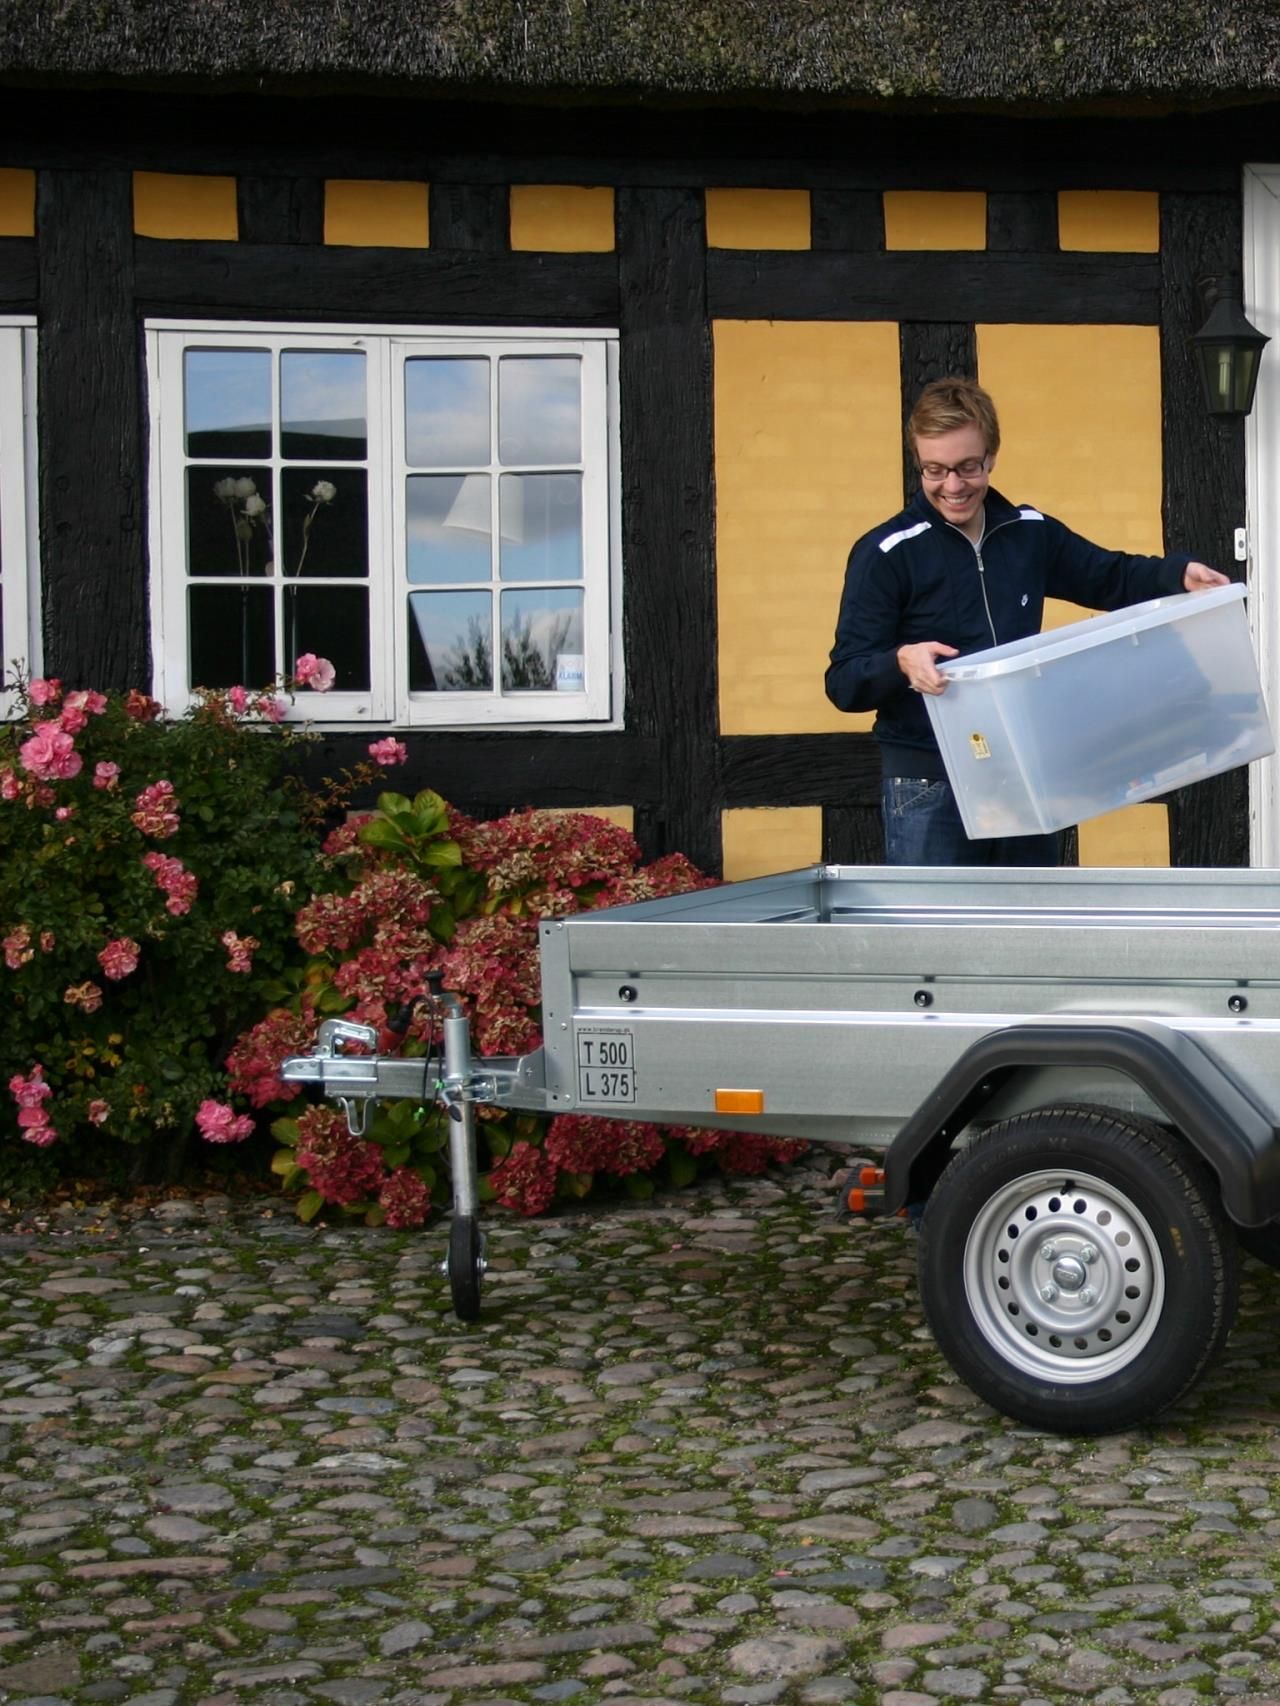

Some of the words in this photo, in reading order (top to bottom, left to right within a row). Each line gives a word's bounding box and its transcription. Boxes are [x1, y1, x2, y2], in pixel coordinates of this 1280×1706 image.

[584, 1041, 594, 1064] T
[600, 1042, 627, 1065] 500
[586, 1072, 596, 1095] L
[601, 1073, 629, 1096] 375
